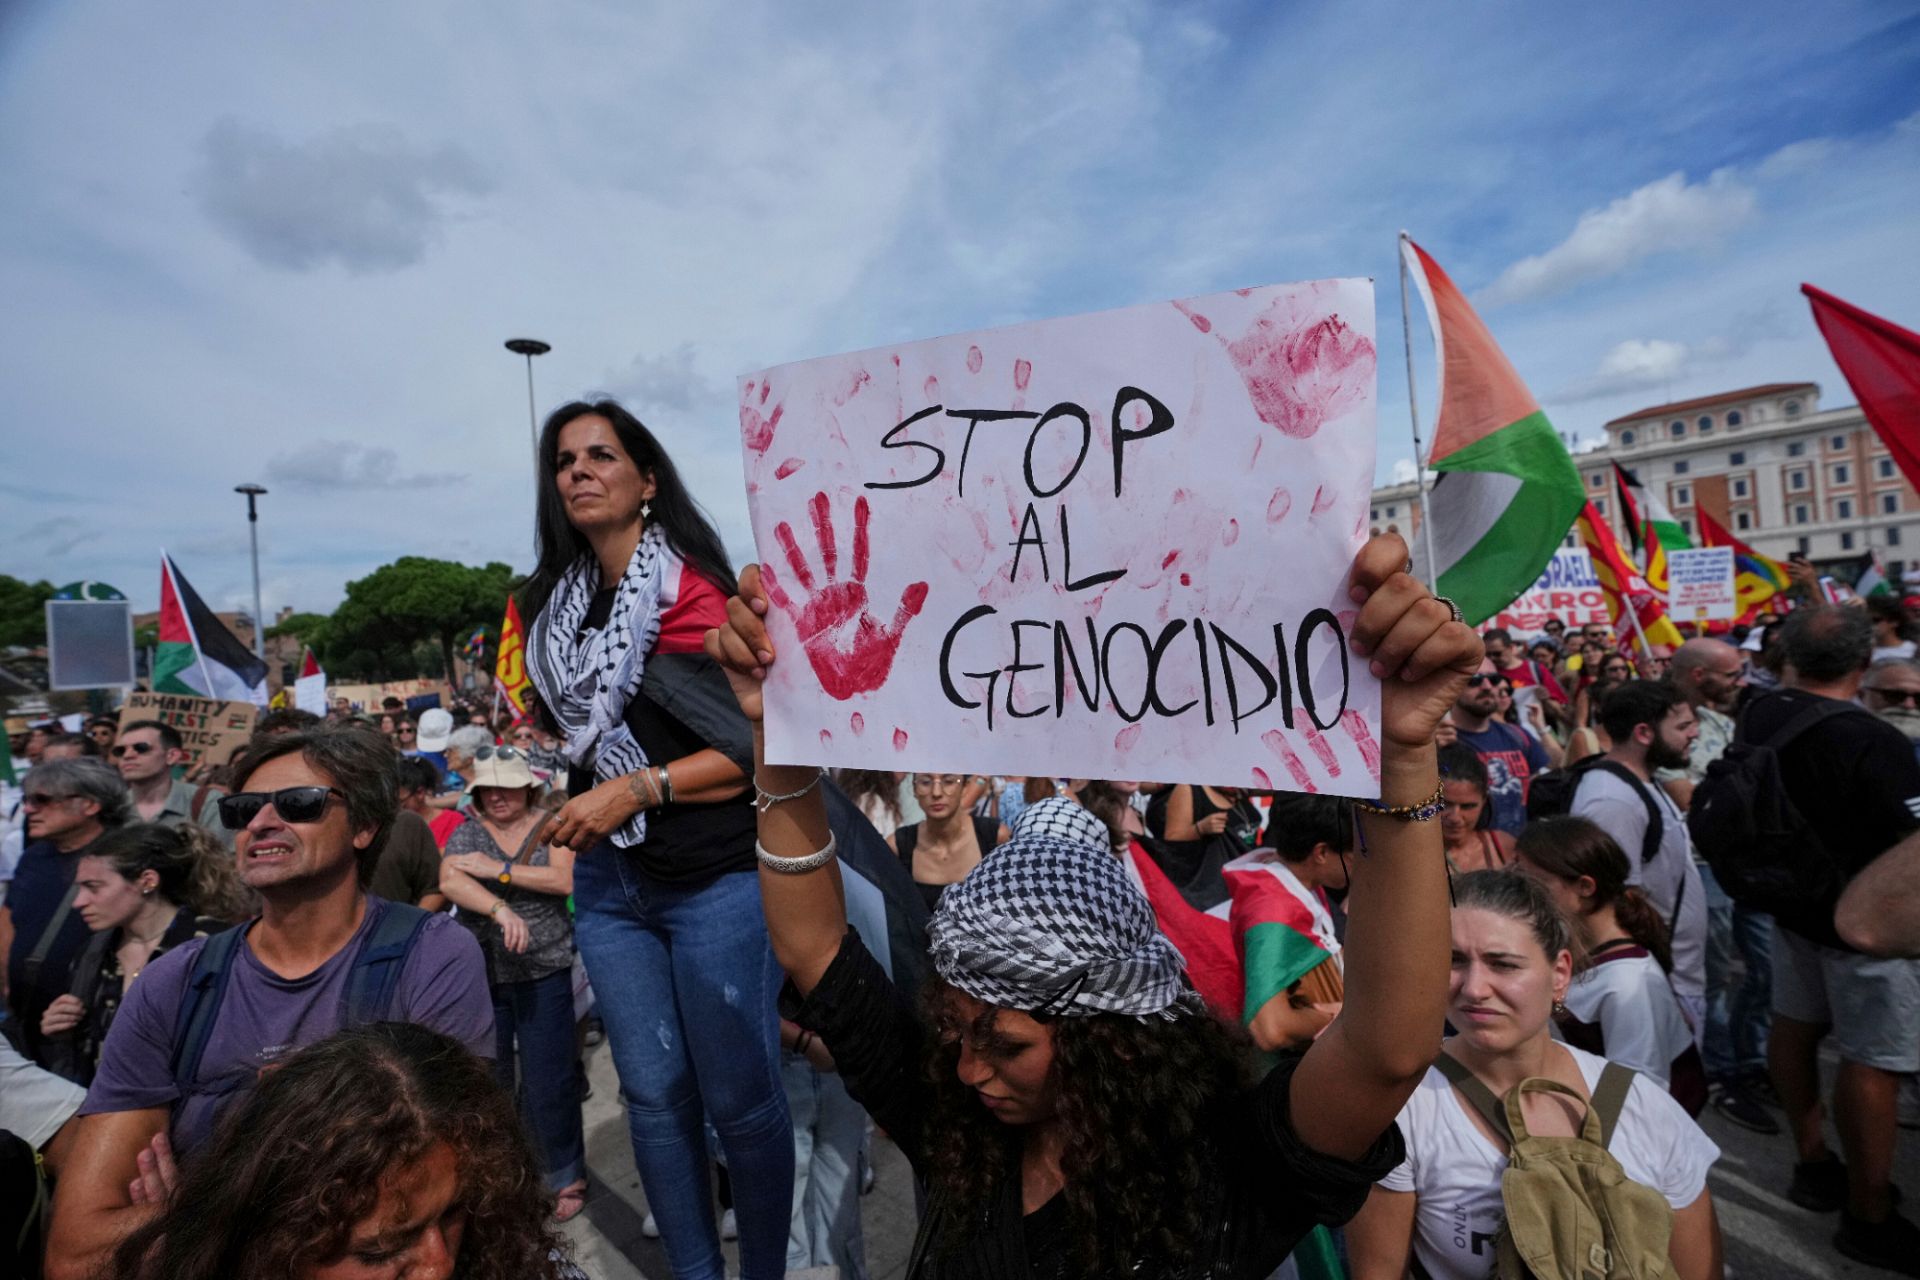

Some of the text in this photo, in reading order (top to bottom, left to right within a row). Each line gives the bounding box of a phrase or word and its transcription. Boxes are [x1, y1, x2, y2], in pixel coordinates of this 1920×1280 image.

[864, 386, 1174, 498] STOP
[1009, 503, 1127, 591] AL
[940, 605, 1350, 734] GENOCIDIO
[1453, 1203, 1467, 1249] ONLY
